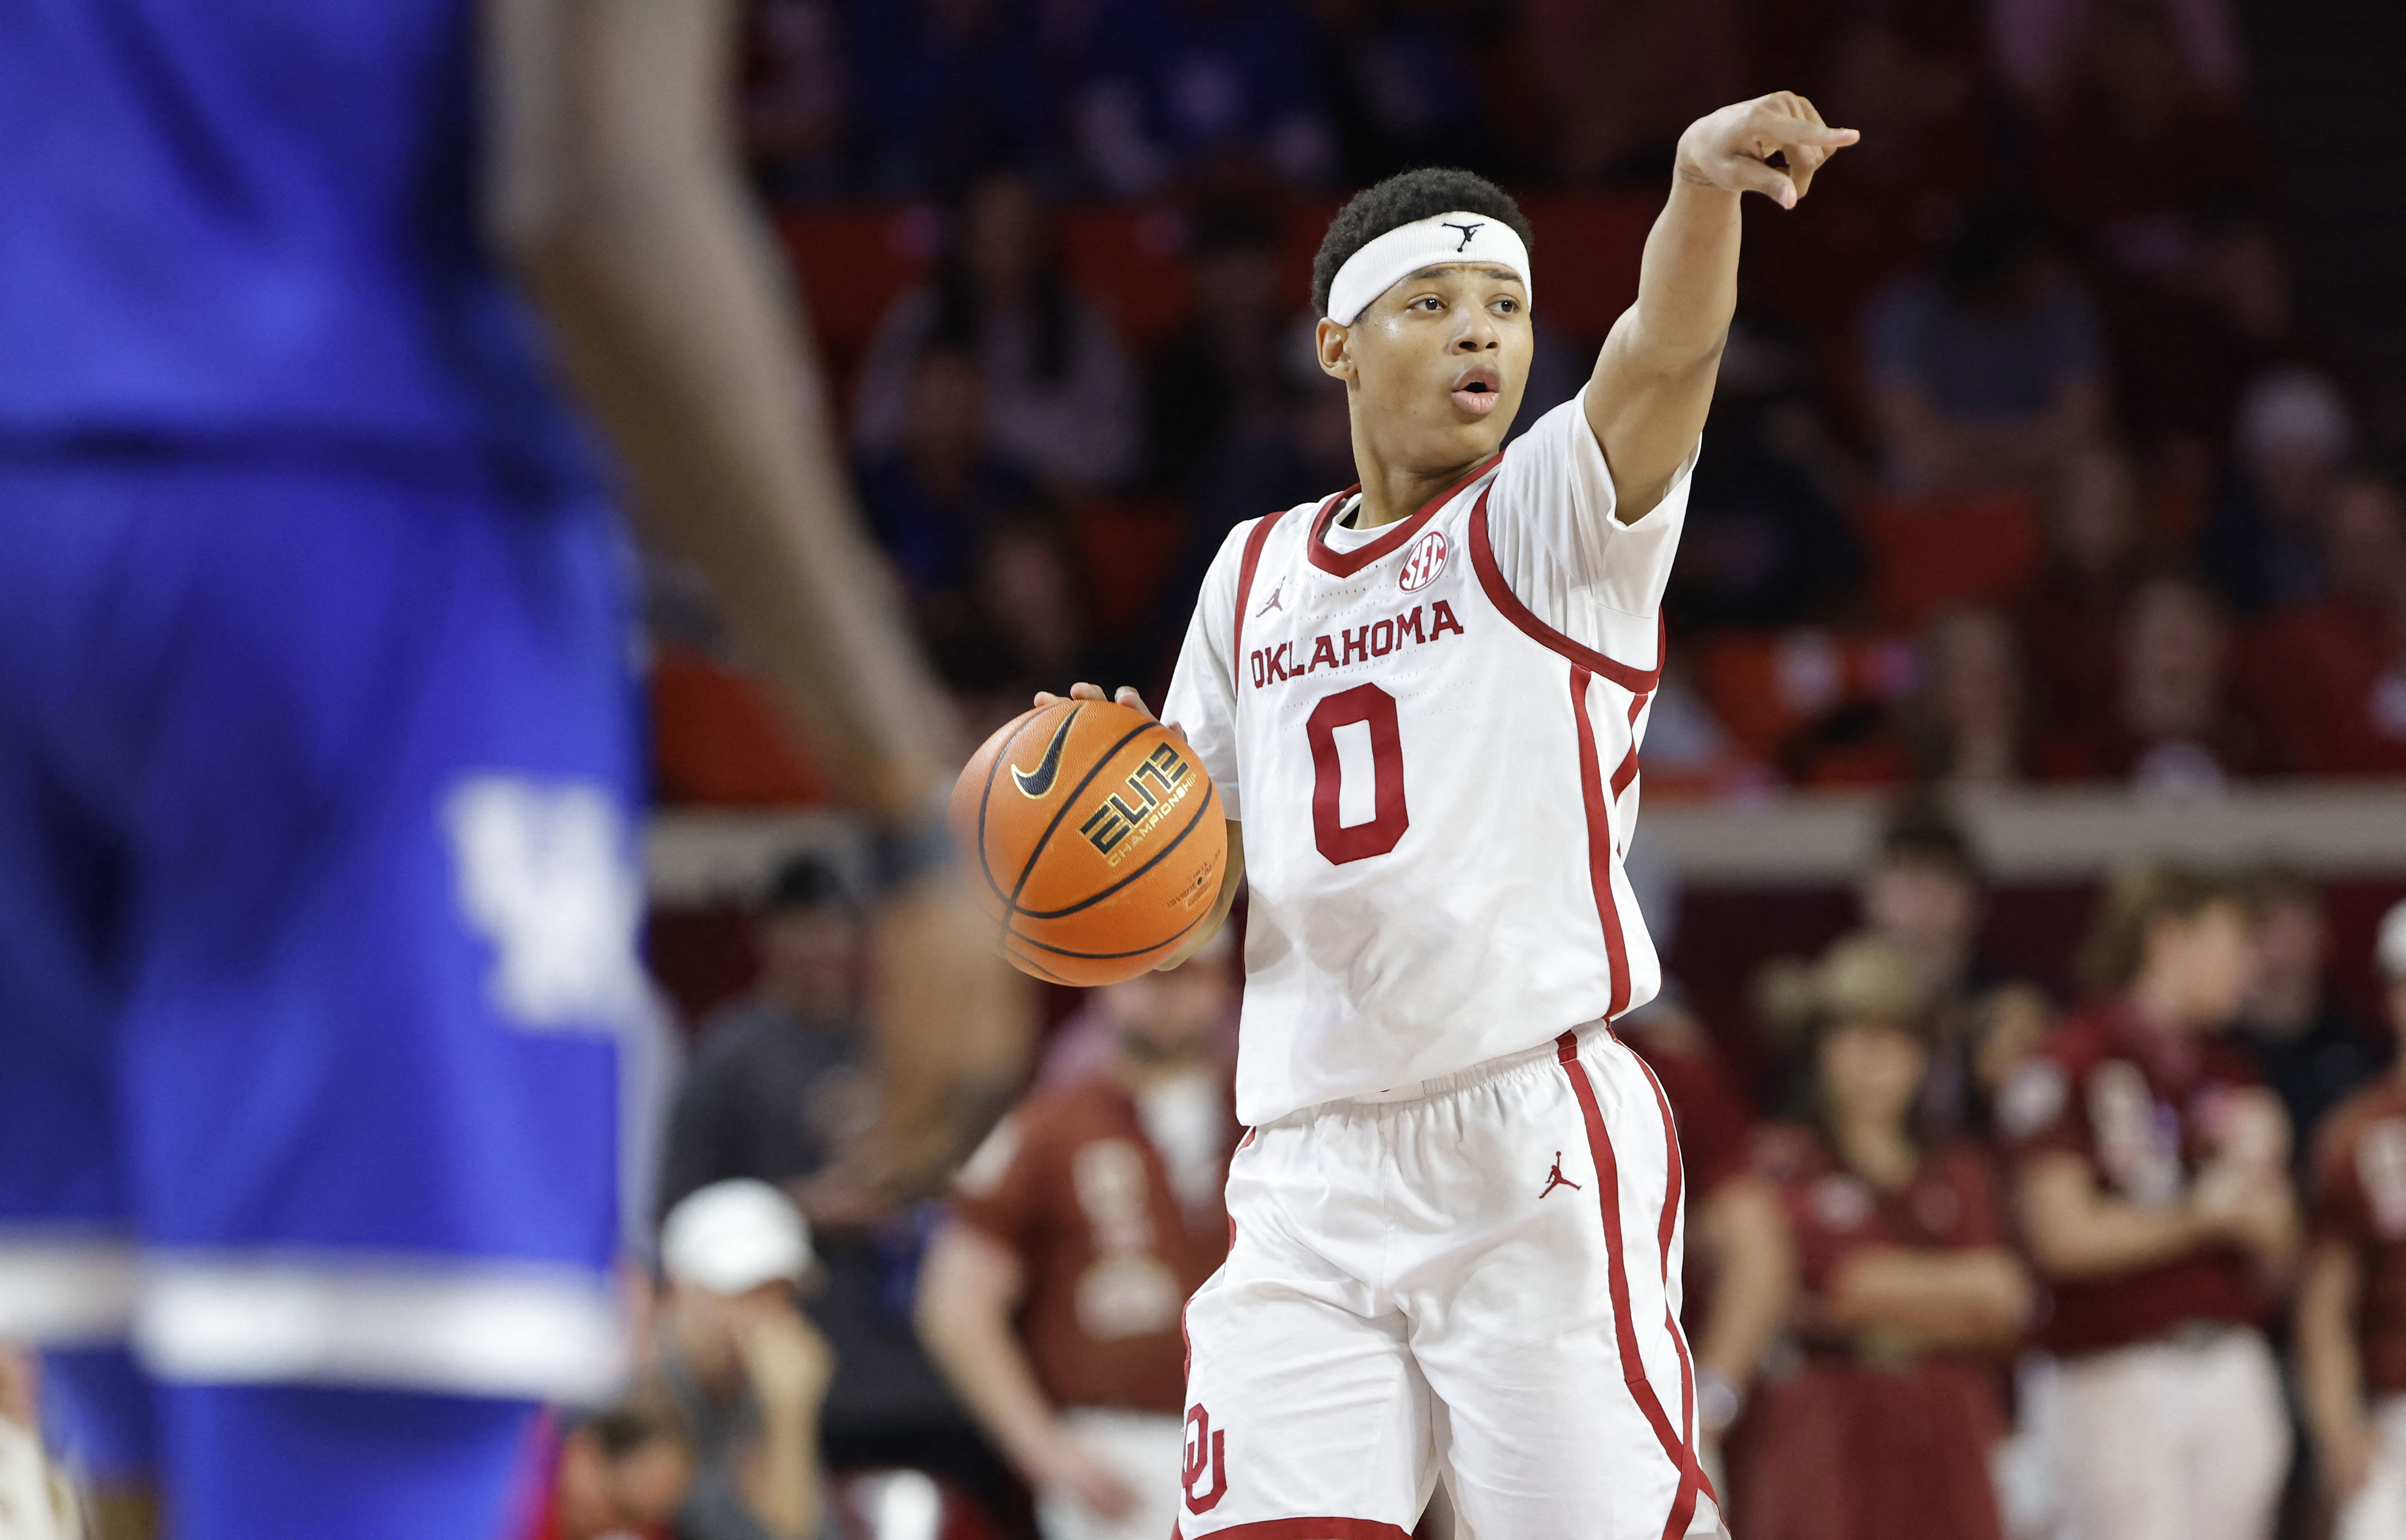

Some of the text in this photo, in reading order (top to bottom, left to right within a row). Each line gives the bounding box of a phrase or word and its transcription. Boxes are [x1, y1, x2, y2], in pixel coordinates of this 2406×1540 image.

[1401, 531, 1446, 590] SEC
[1251, 600, 1464, 689] OKLAHOMA
[1079, 741, 1189, 857] ELITE
[1108, 773, 1197, 866] CHAMPIONSHIP
[1306, 682, 1409, 866] 0
[1182, 1403, 1227, 1515] OU
